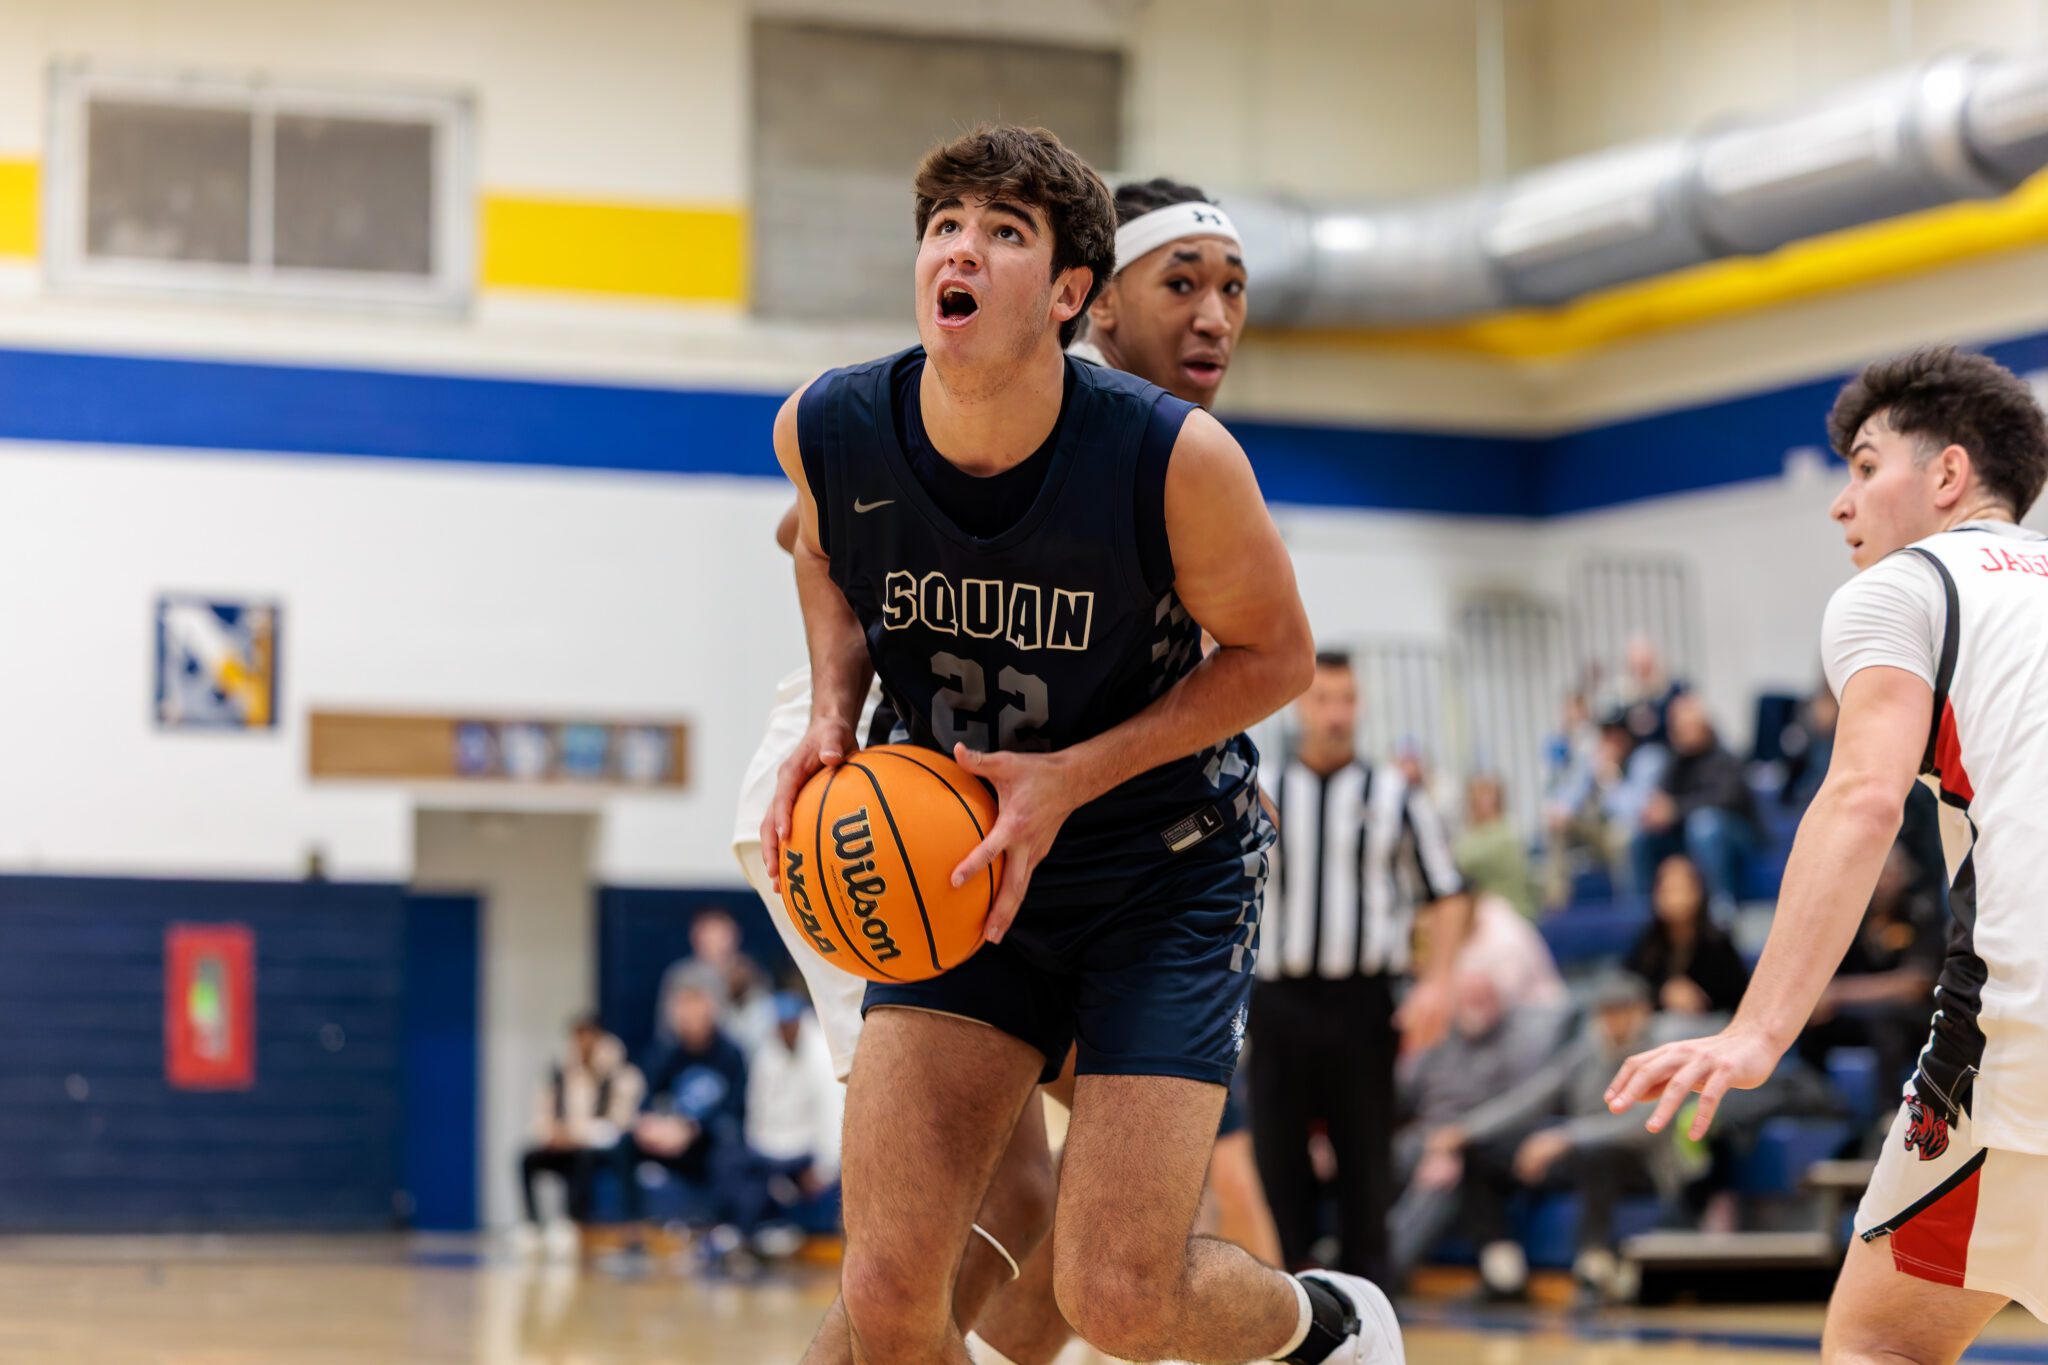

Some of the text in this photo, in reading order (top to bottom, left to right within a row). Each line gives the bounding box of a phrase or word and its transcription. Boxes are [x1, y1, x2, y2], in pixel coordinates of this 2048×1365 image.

[883, 570, 1094, 650] SQUAN
[930, 651, 1050, 754] 22
[1203, 815, 1214, 826] L
[786, 848, 838, 955] NCAA
[831, 804, 902, 963] Wilson
